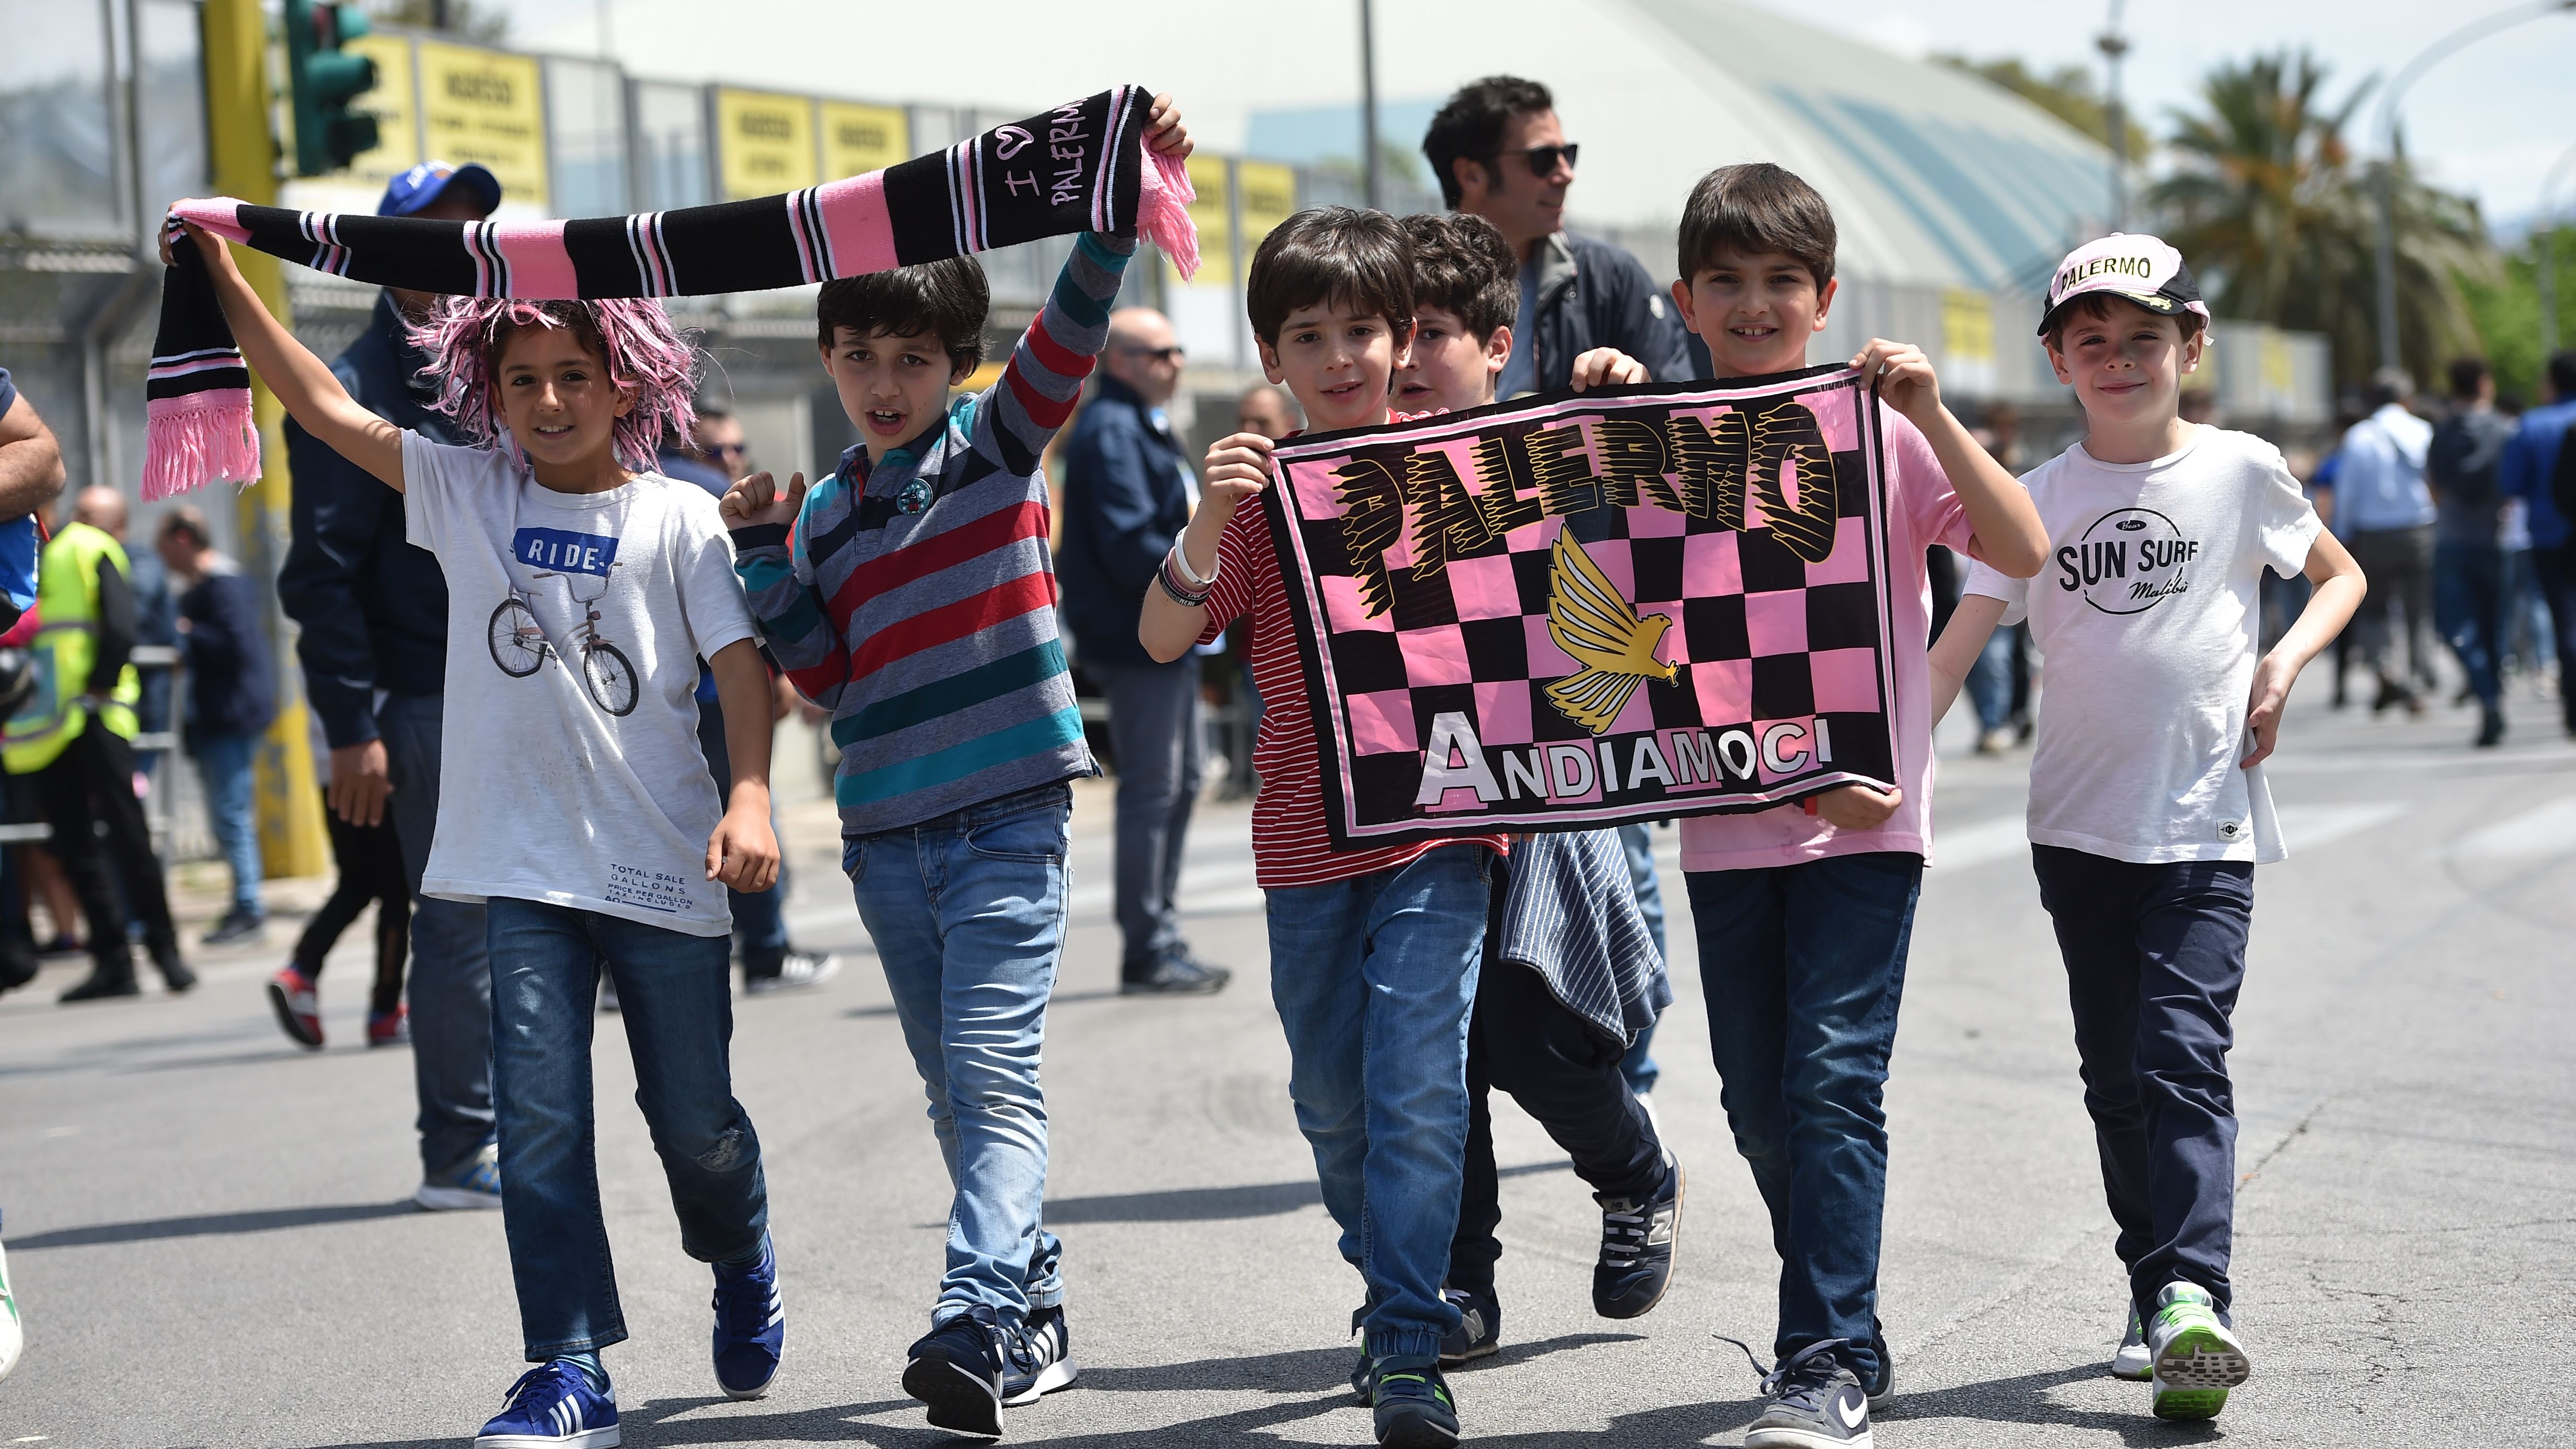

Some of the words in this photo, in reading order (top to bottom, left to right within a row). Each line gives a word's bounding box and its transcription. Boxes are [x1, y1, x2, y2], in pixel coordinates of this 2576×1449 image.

[1049, 98, 1089, 206] PALERM
[1005, 170, 1040, 197] I
[2058, 257, 2151, 298] PALERMO
[1327, 402, 1838, 620] PALERMO
[2057, 542, 2126, 592] SUN
[2137, 539, 2199, 572] SURF
[1161, 581, 1195, 606] BIANCONERI
[611, 864, 650, 878] TOTAL
[656, 873, 685, 884] SALE
[611, 874, 685, 894] GALLONS
[608, 883, 632, 893] PRICE
[656, 894, 693, 905] GALLON
[633, 895, 691, 910] INCLUDED
